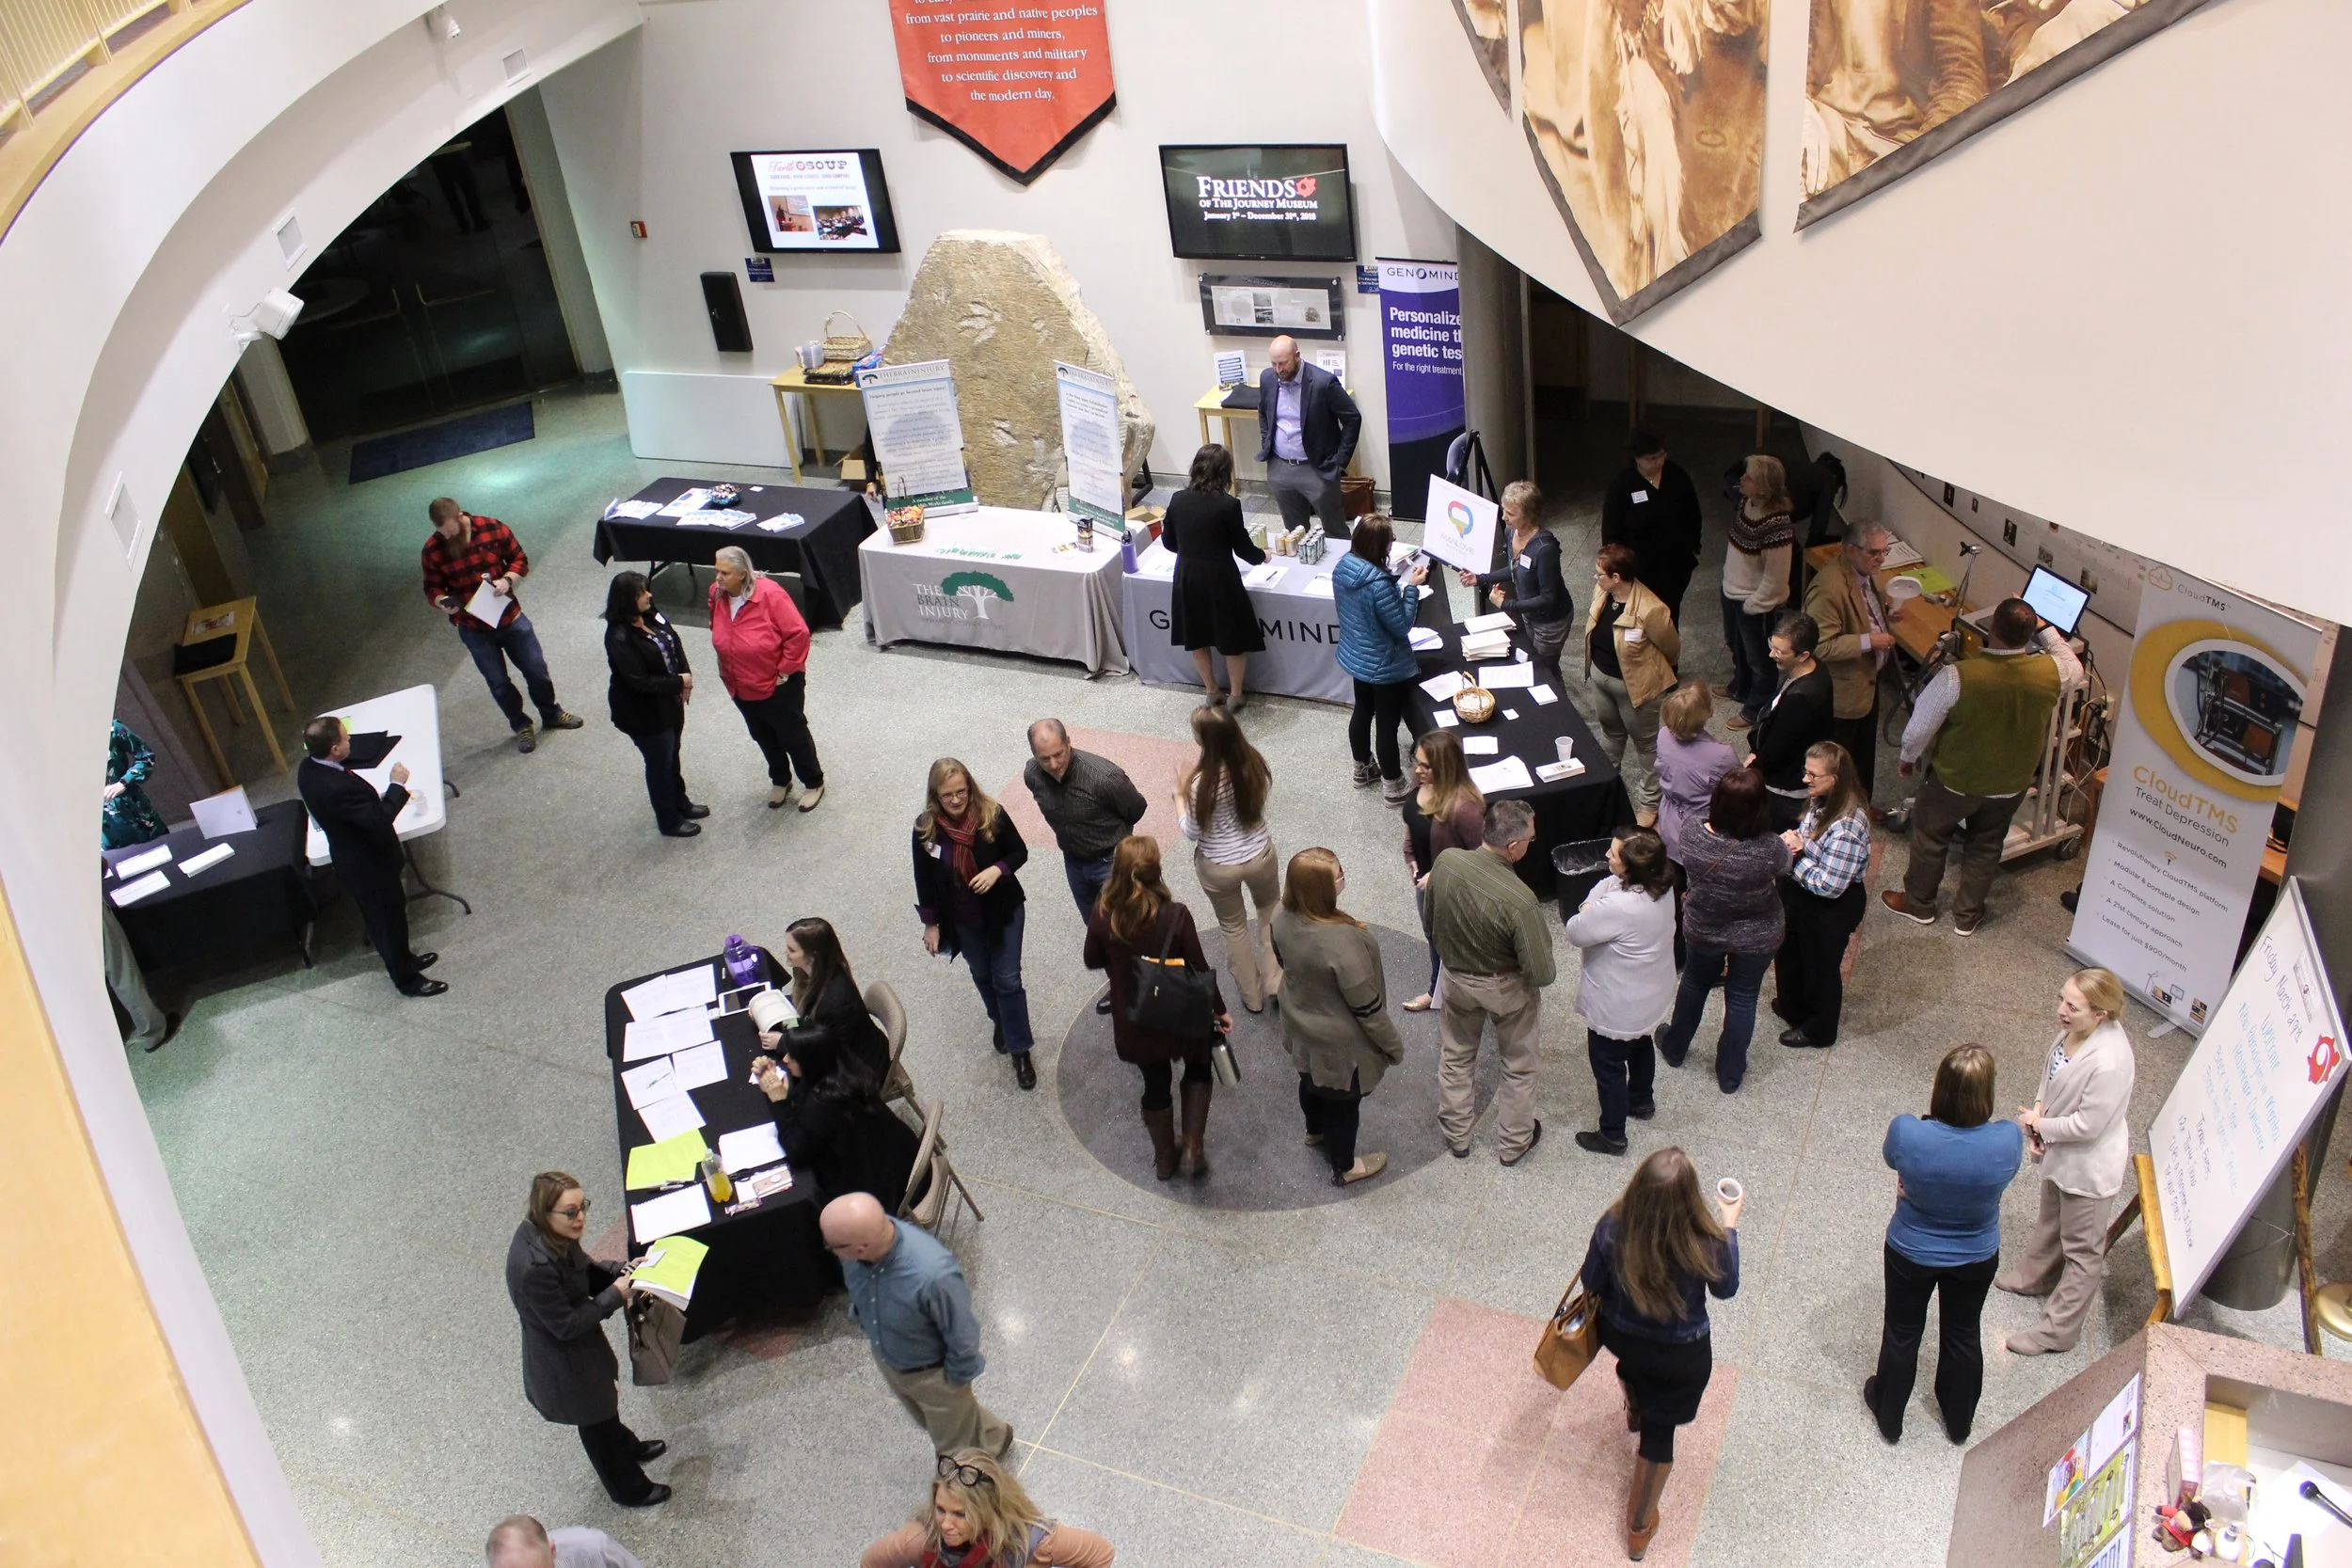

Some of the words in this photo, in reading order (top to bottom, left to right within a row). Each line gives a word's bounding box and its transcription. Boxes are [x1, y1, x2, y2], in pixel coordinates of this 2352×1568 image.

[906, 13, 930, 24] from
[934, 13, 954, 22] vast
[958, 11, 990, 24] prairie
[993, 8, 1015, 21] and
[1019, 8, 1047, 19] native
[1051, 5, 1097, 21] peoples
[941, 33, 952, 43] to
[955, 30, 998, 44] pioneers
[1002, 28, 1024, 40] and
[1027, 28, 1065, 40] miners,
[928, 52, 953, 63] from
[957, 49, 1019, 62] monuments
[1023, 48, 1042, 59] and
[1045, 48, 1087, 61] military
[942, 73, 953, 82] to
[957, 70, 999, 81] scientific
[1003, 67, 1053, 81] discovery
[1056, 68, 1076, 79] and
[971, 90, 986, 101] the
[989, 89, 1031, 101] modern
[1035, 88, 1054, 102] day.
[1197, 176, 1296, 198] FRIENDS
[1200, 199, 1211, 208] OF
[1212, 198, 1233, 207] THE
[1233, 198, 1274, 210] JOURNEY
[1276, 198, 1317, 209] MUSEUM
[1204, 212, 1231, 221] January
[1391, 326, 1449, 341] medicine
[1392, 344, 1439, 358] genetic
[1393, 361, 1403, 370] For
[1405, 362, 1415, 372] the
[1416, 363, 1431, 373] right
[913, 583, 942, 596] THE
[2178, 585, 2225, 611] CloudTMS
[917, 594, 959, 607] BRAIN
[918, 605, 968, 619] INJURY
[2134, 766, 2237, 833] CloudTMS
[2136, 787, 2162, 809] Treat
[2165, 804, 2228, 846] Depression
[2130, 809, 2226, 868] www.CloudNeuro.com
[2117, 843, 2161, 873] Revolutionary
[2163, 870, 2197, 892] CloudTMS
[2199, 891, 2228, 912] platform
[2114, 861, 2140, 879] Modular
[2147, 883, 2175, 901] portable
[2177, 900, 2199, 915] design
[2118, 883, 2146, 906] Complete
[2148, 905, 2175, 922] solution
[2113, 901, 2125, 912] 21st
[2127, 910, 2149, 928] century
[2151, 927, 2182, 948] approach
[2102, 915, 2120, 929] Lease
[2131, 935, 2142, 945] just
[2145, 943, 2186, 971] $900/month
[2259, 929, 2277, 982] Friday
[2276, 975, 2292, 1013] March
